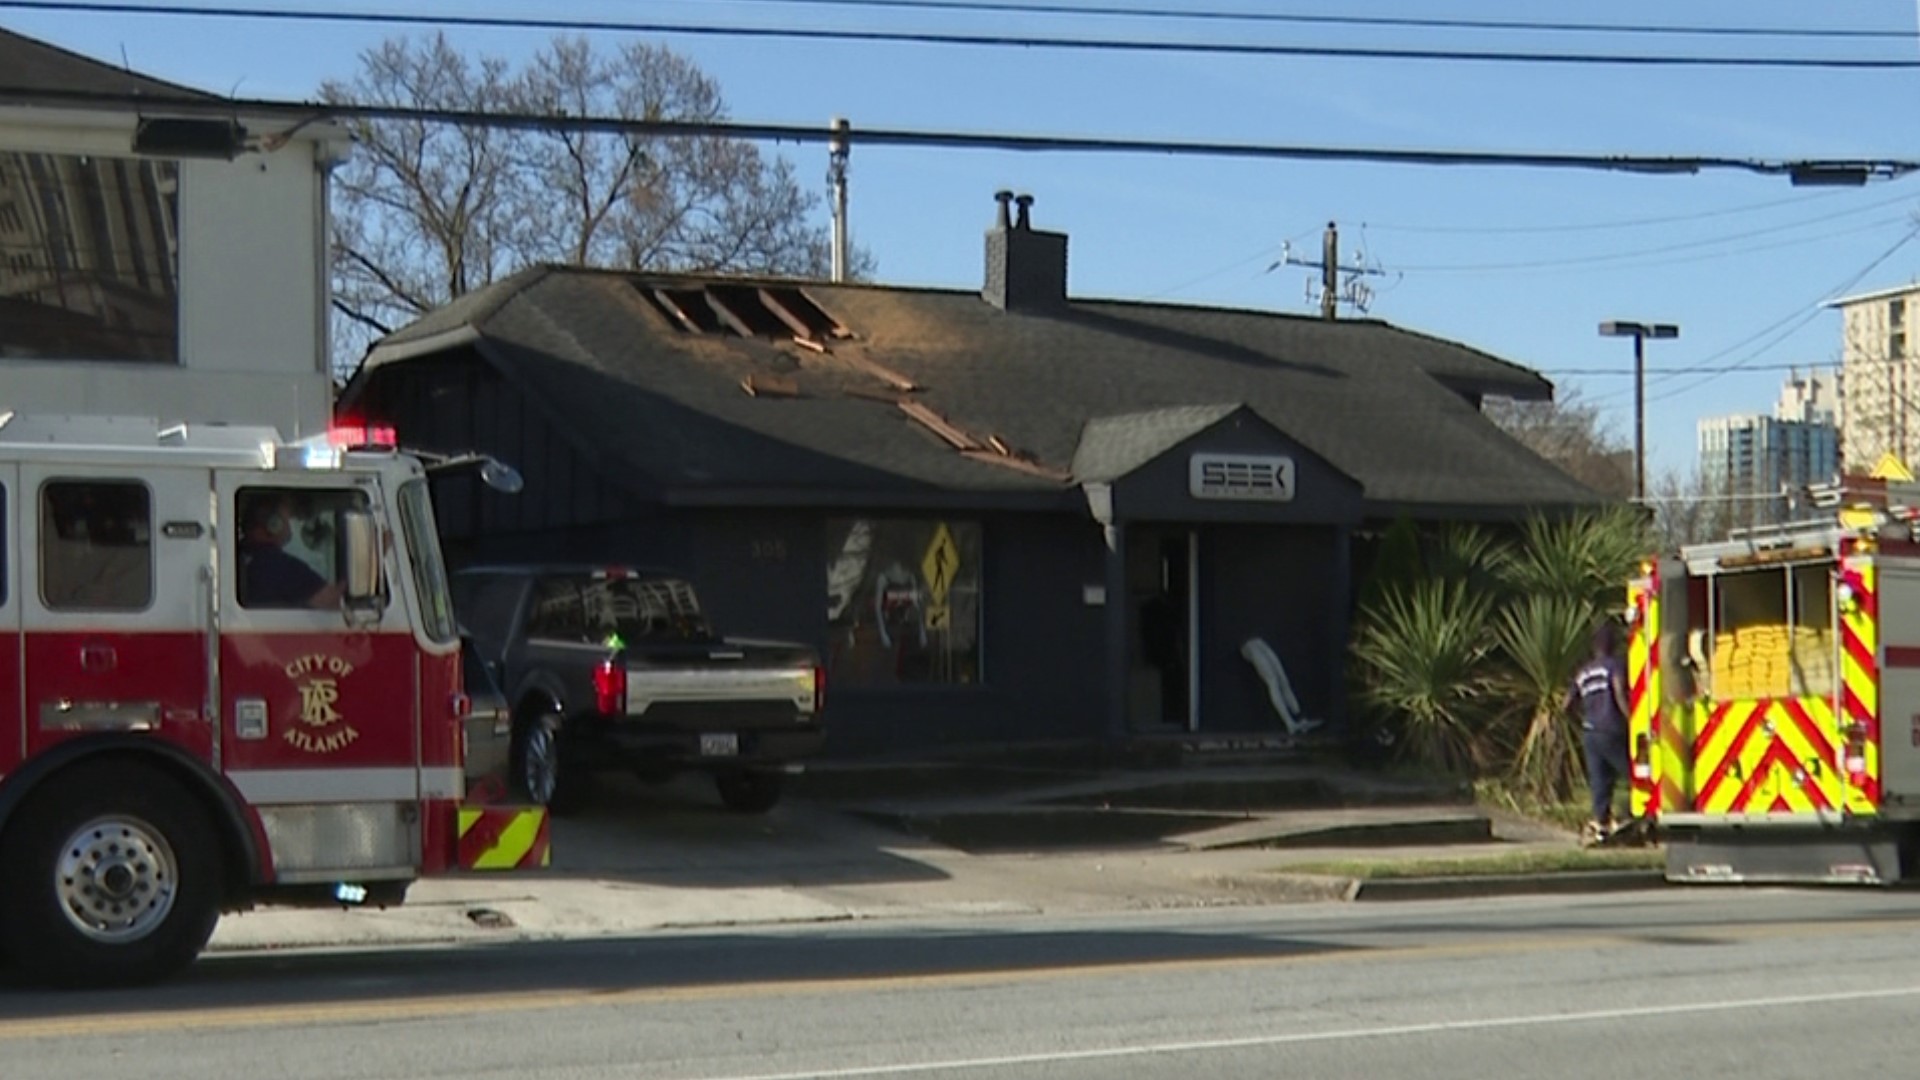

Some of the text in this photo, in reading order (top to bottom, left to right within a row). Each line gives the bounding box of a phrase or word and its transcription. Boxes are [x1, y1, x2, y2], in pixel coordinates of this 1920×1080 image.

[285, 654, 354, 679] CITY OF
[283, 726, 359, 753] ATLANTA
